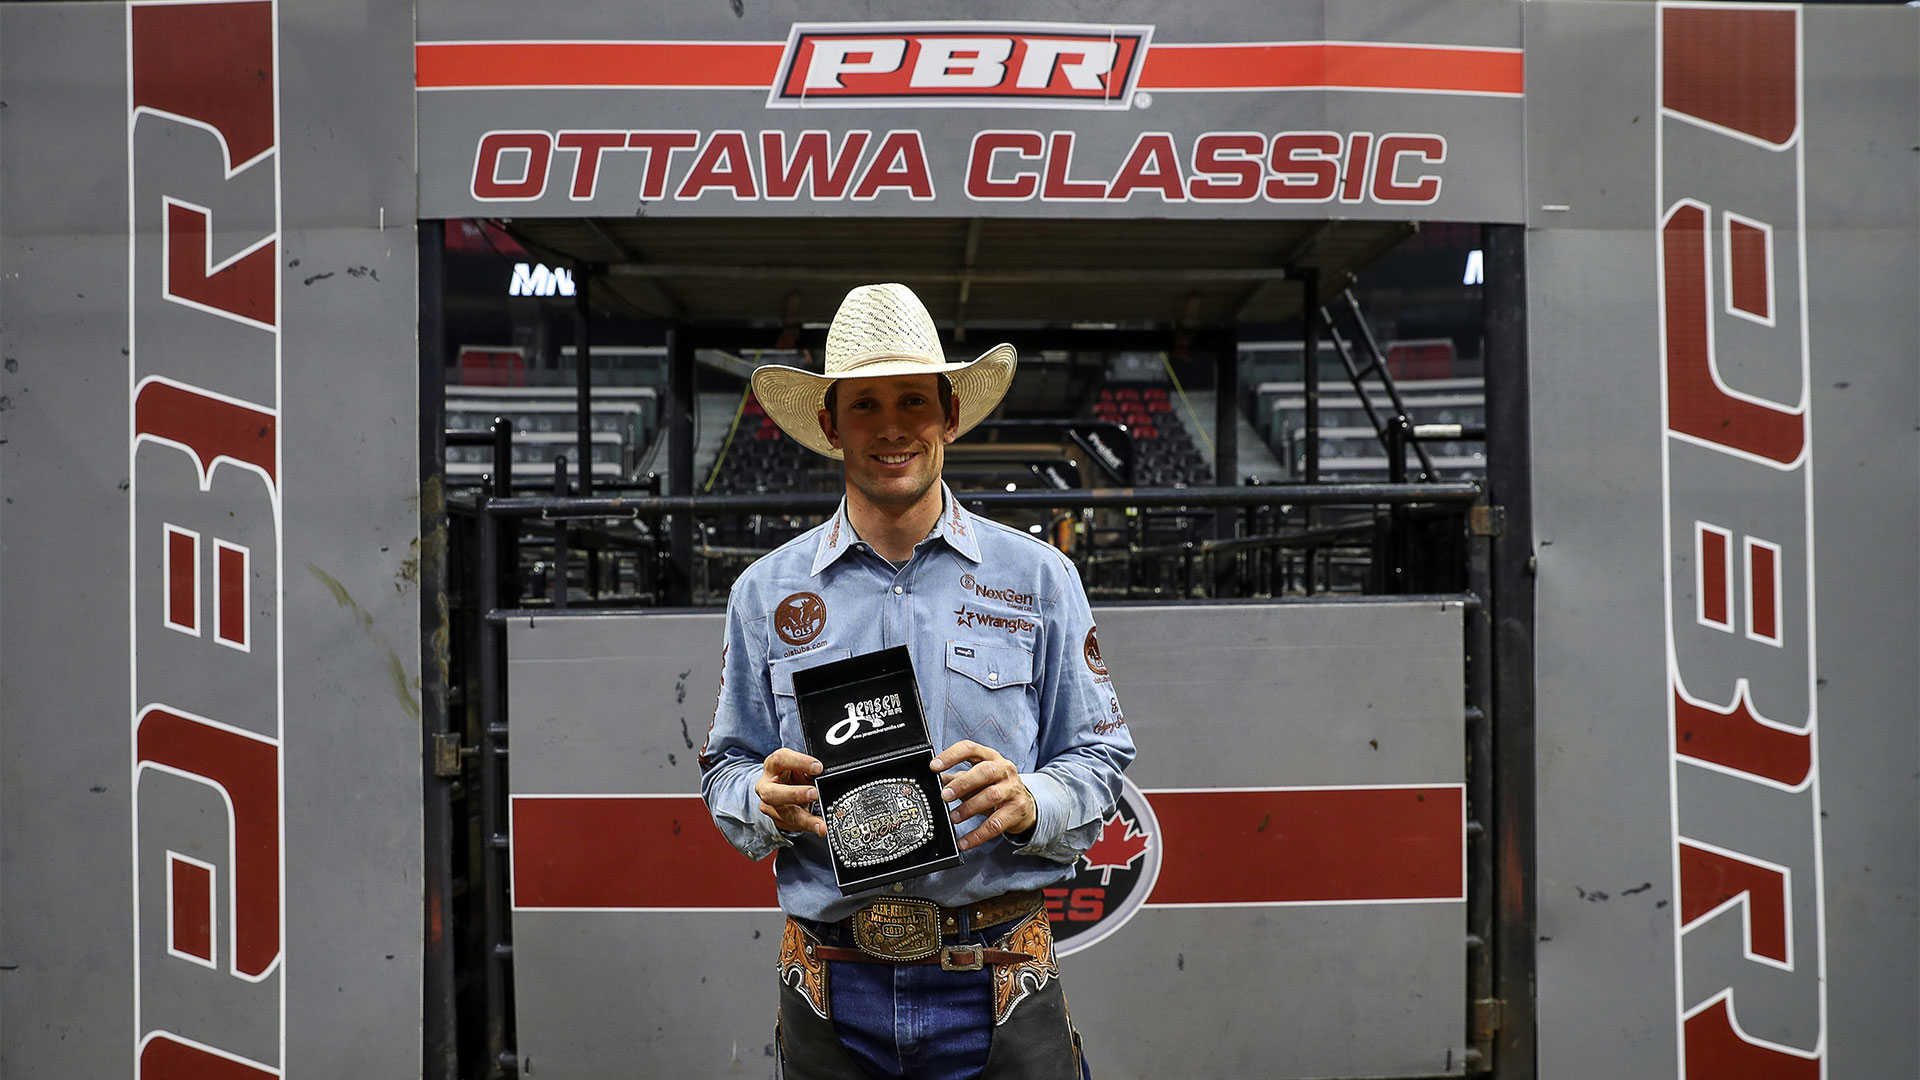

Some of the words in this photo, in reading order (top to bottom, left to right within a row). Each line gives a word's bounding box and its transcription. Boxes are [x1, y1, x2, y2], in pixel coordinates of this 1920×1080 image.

[803, 38, 1119, 90] PBR
[470, 129, 936, 202] OTTAWA
[964, 129, 1447, 205] CLASSIC
[509, 264, 576, 296] MN
[132, 106, 283, 1074] PBR
[975, 583, 1033, 606] NexGen
[1660, 108, 1827, 1058] PBR
[794, 626, 812, 637] OLS
[976, 611, 1035, 634] Wrangler
[870, 911, 921, 924] MEMORIAL
[1042, 887, 1106, 922] ES
